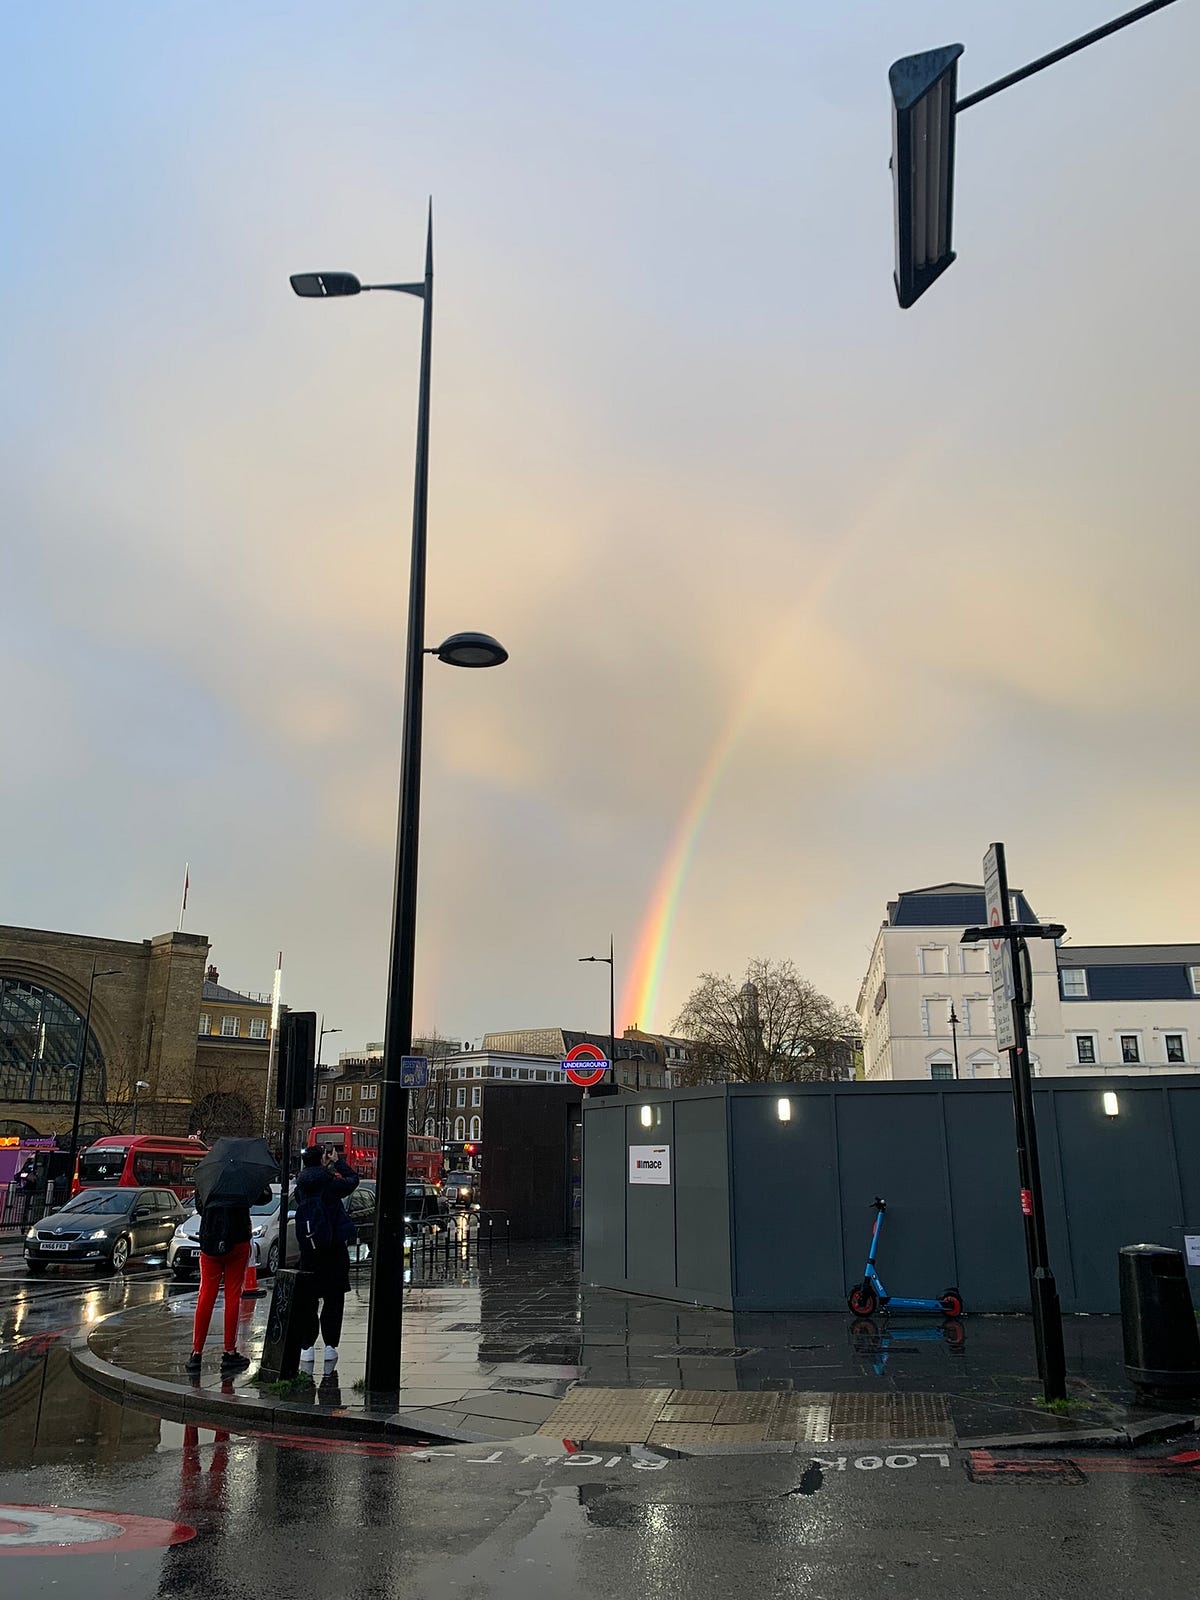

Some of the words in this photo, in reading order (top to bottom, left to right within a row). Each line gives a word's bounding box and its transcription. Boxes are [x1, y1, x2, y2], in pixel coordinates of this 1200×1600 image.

[563, 1061, 608, 1069] UNDERGROUND
[643, 1160, 662, 1169] mace
[97, 1165, 107, 1174] 46
[809, 1453, 950, 1471] LOOK
